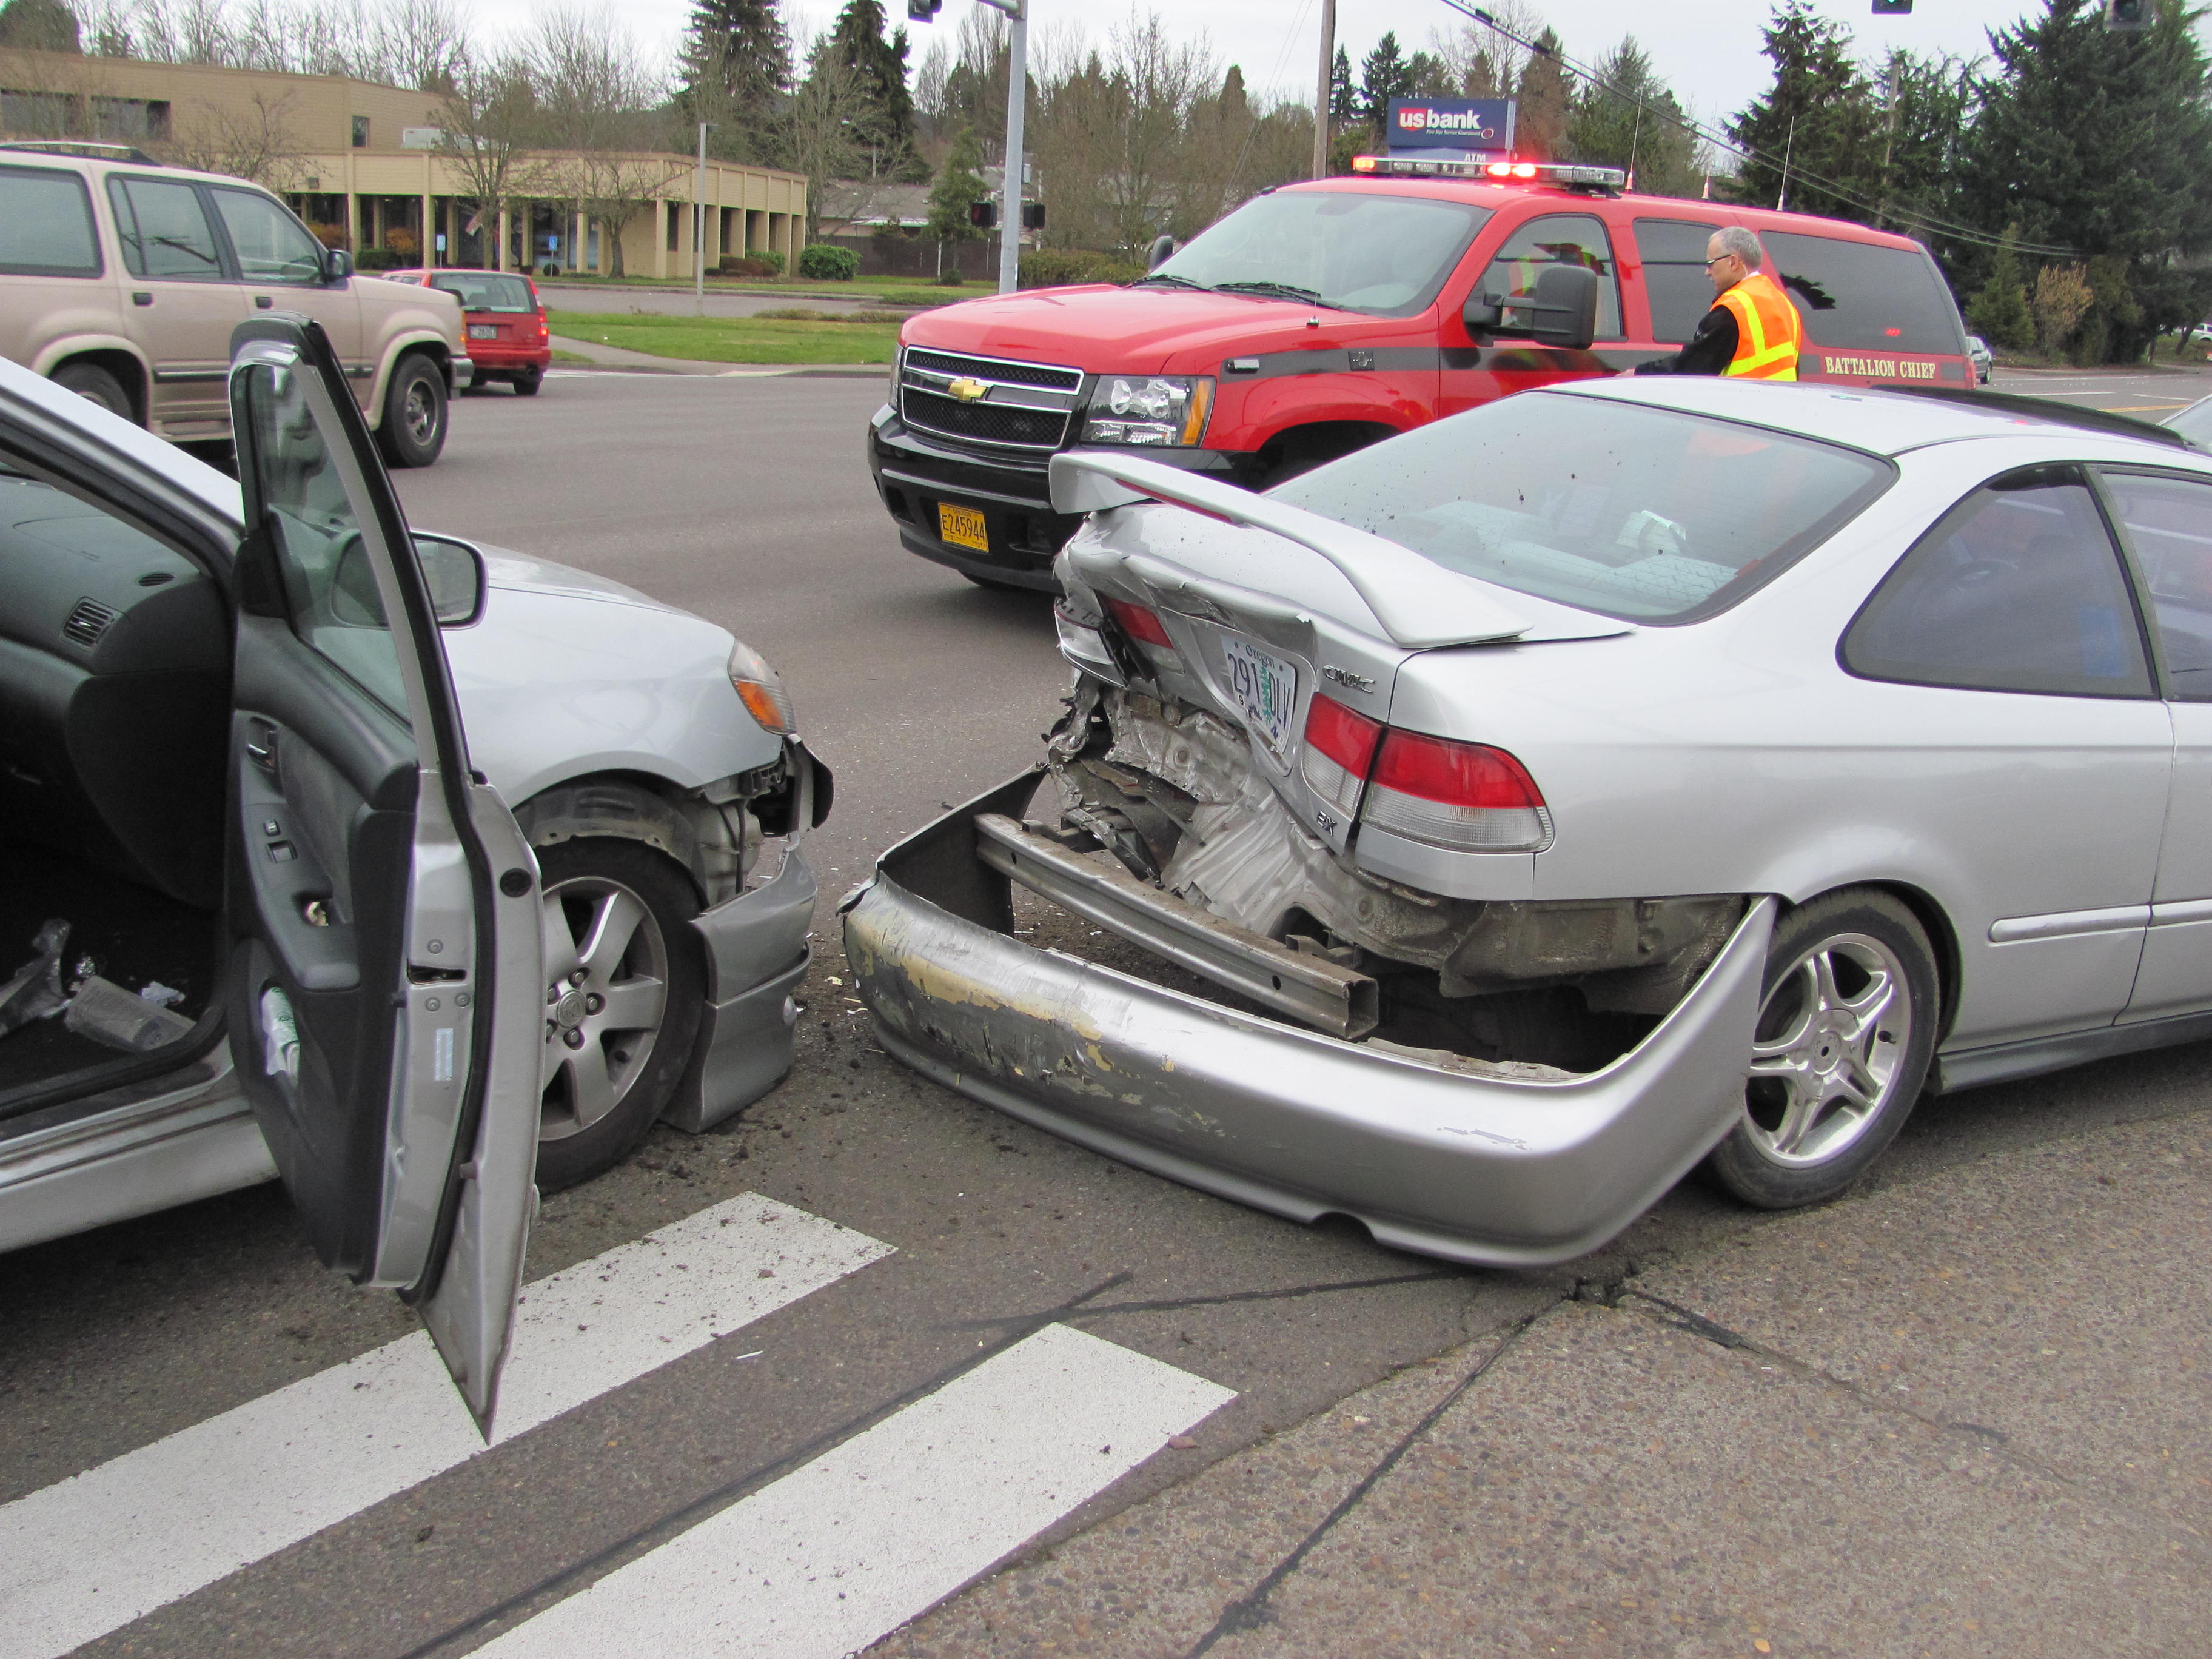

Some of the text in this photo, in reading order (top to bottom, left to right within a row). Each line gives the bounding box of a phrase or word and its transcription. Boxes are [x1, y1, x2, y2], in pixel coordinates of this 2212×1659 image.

[1464, 153, 1486, 162] ATM
[1825, 357, 1936, 379] BATTALION CHIEF
[942, 514, 985, 542] E245944
[1245, 645, 1275, 669] Oregon
[1324, 665, 1375, 694] CIVIC
[1316, 810, 1338, 837] EX
